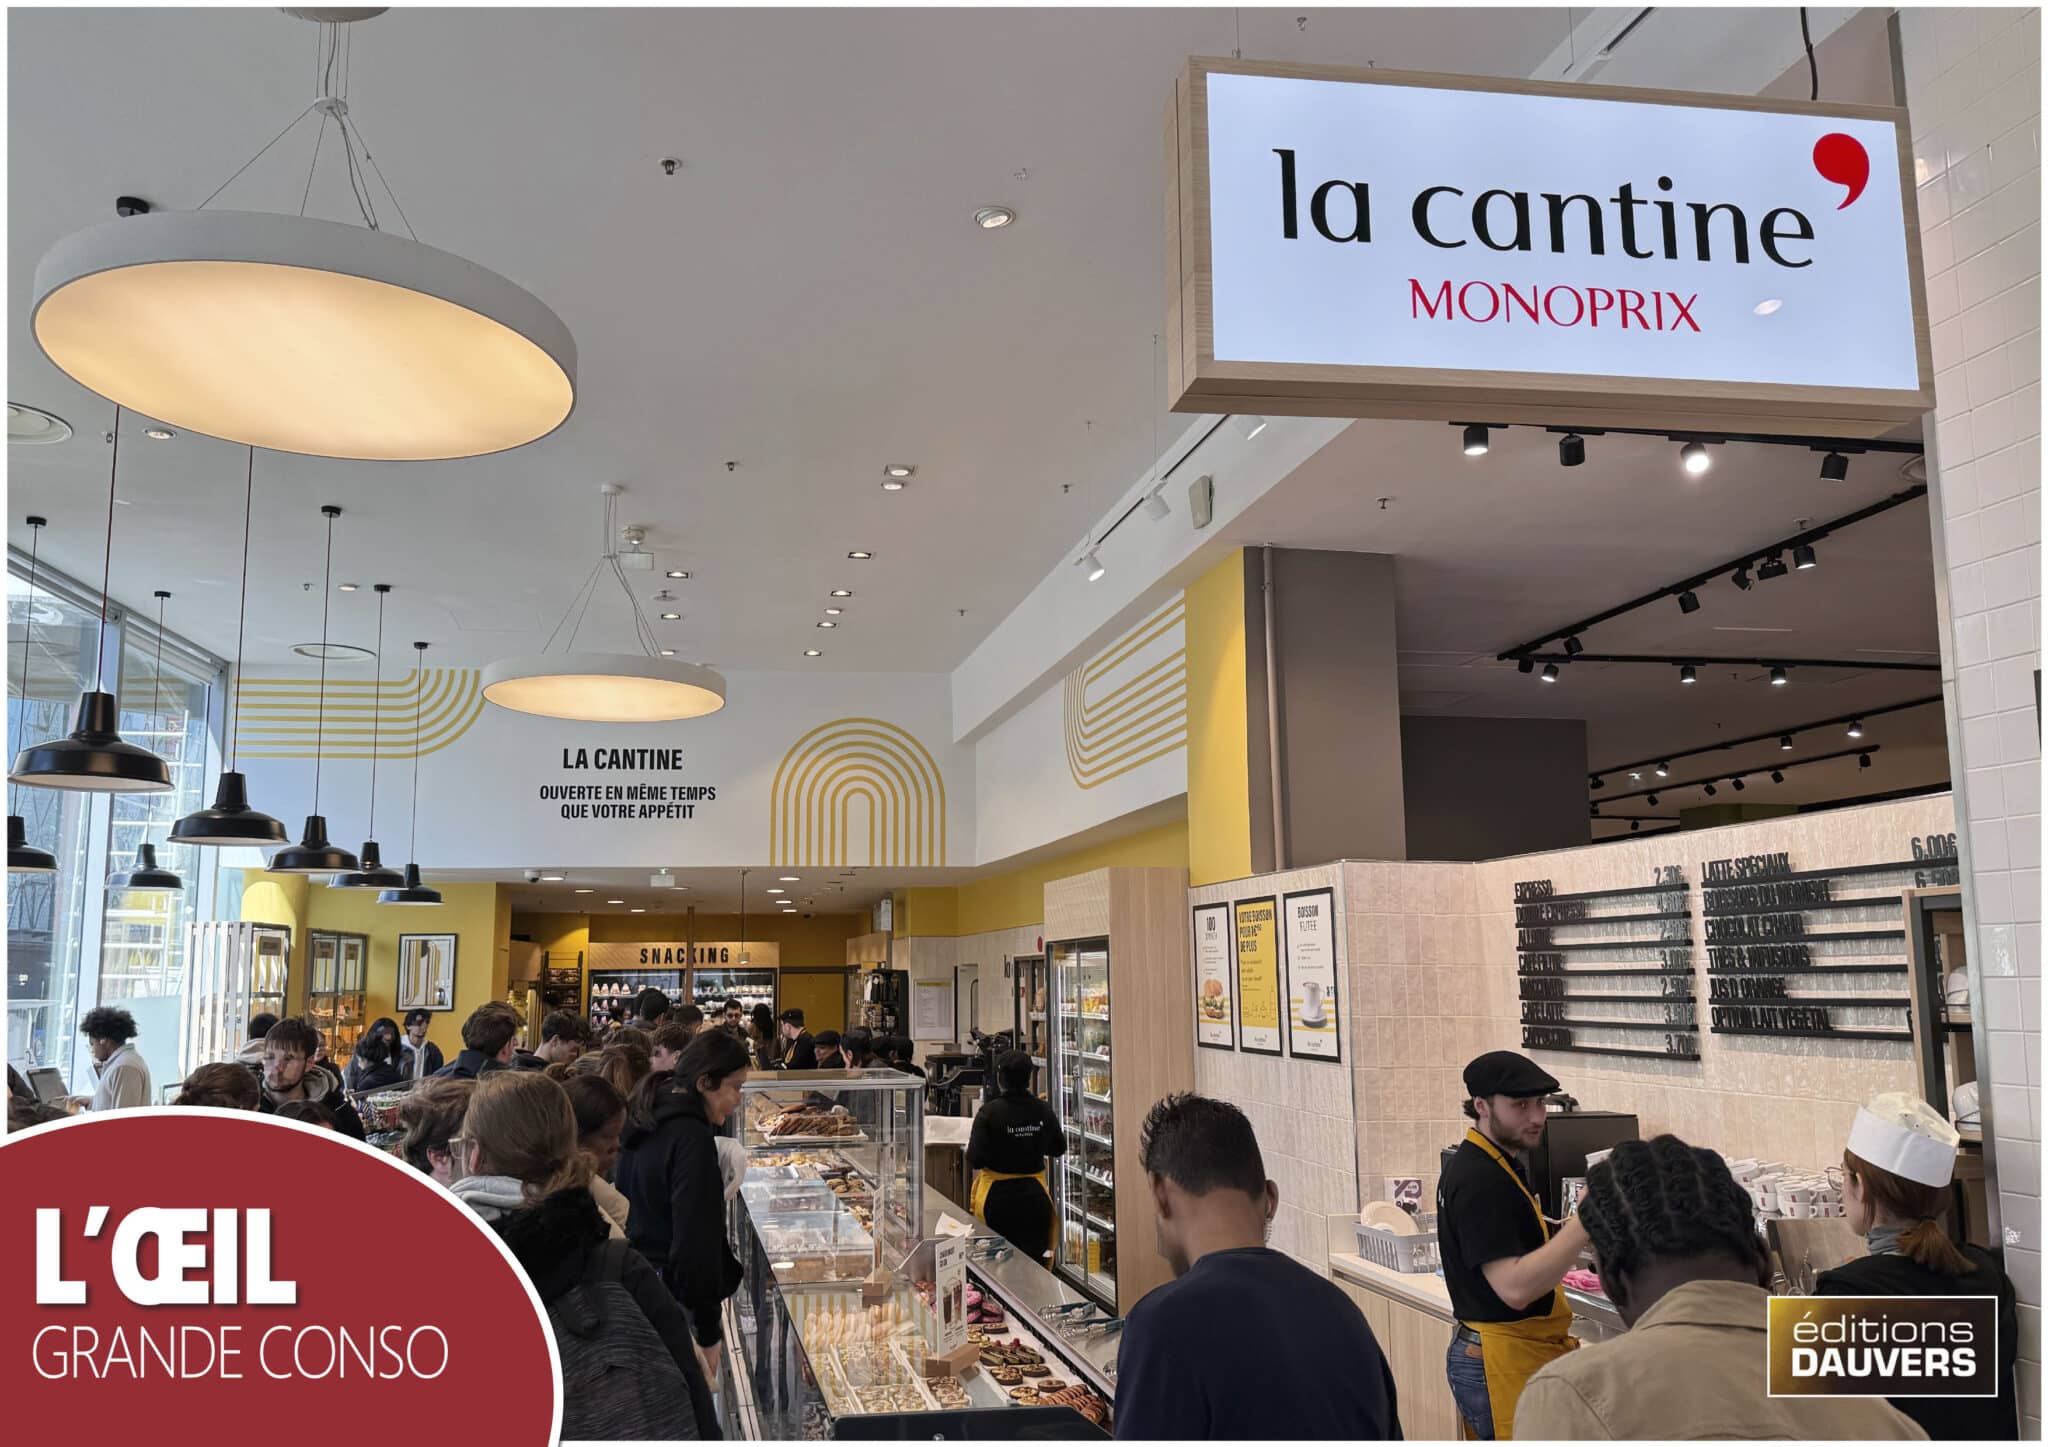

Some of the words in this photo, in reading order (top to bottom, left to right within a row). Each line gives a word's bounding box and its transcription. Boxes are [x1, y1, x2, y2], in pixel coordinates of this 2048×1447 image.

[1272, 147, 1372, 243] la
[1408, 278, 1701, 333] MONOPRIX
[562, 748, 589, 769] LA
[594, 748, 683, 770] CANTINE
[540, 785, 602, 800] OUVERTE
[605, 786, 623, 800] EN
[627, 783, 667, 800] MÊME
[671, 786, 716, 801] TEMPS
[561, 804, 589, 820] QUE
[592, 804, 636, 819] VOTRE
[638, 801, 695, 819] APPÉTIT
